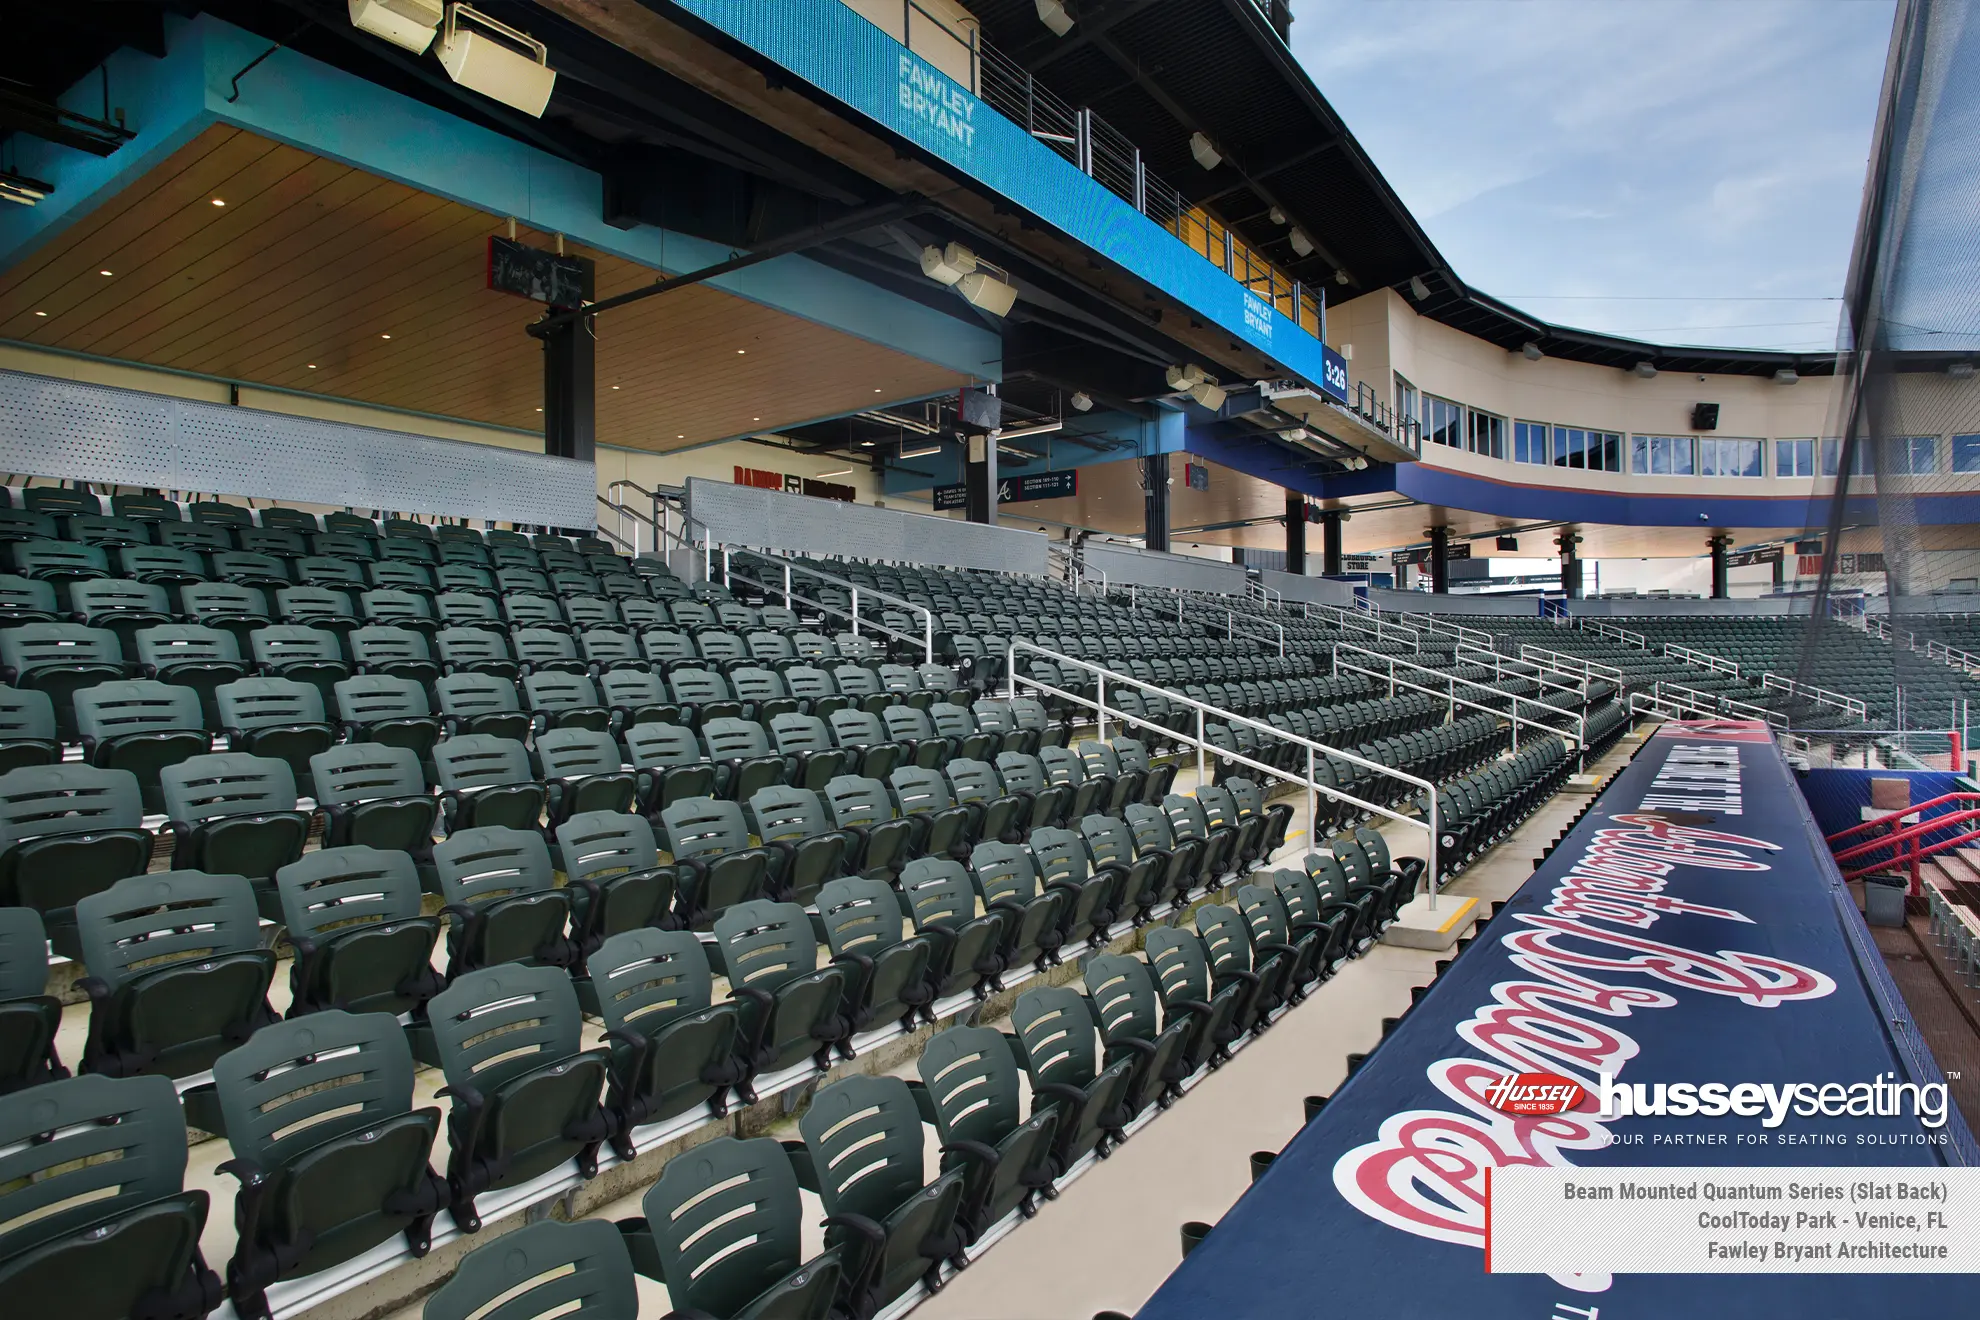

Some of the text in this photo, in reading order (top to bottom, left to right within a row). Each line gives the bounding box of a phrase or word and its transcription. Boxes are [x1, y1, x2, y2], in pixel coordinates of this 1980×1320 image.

[899, 54, 974, 122] FAWLEY
[899, 82, 974, 146] BRYANT
[1243, 293, 1272, 323] FAWLEY
[1244, 309, 1273, 339] BRYANT
[1325, 360, 1346, 390] 3:26
[1347, 561, 1369, 570] STORE
[1650, 780, 1741, 794] OF
[1638, 793, 1743, 815] THE
[1542, 813, 1783, 929] Atlanta
[1332, 912, 1837, 1292] Braves
